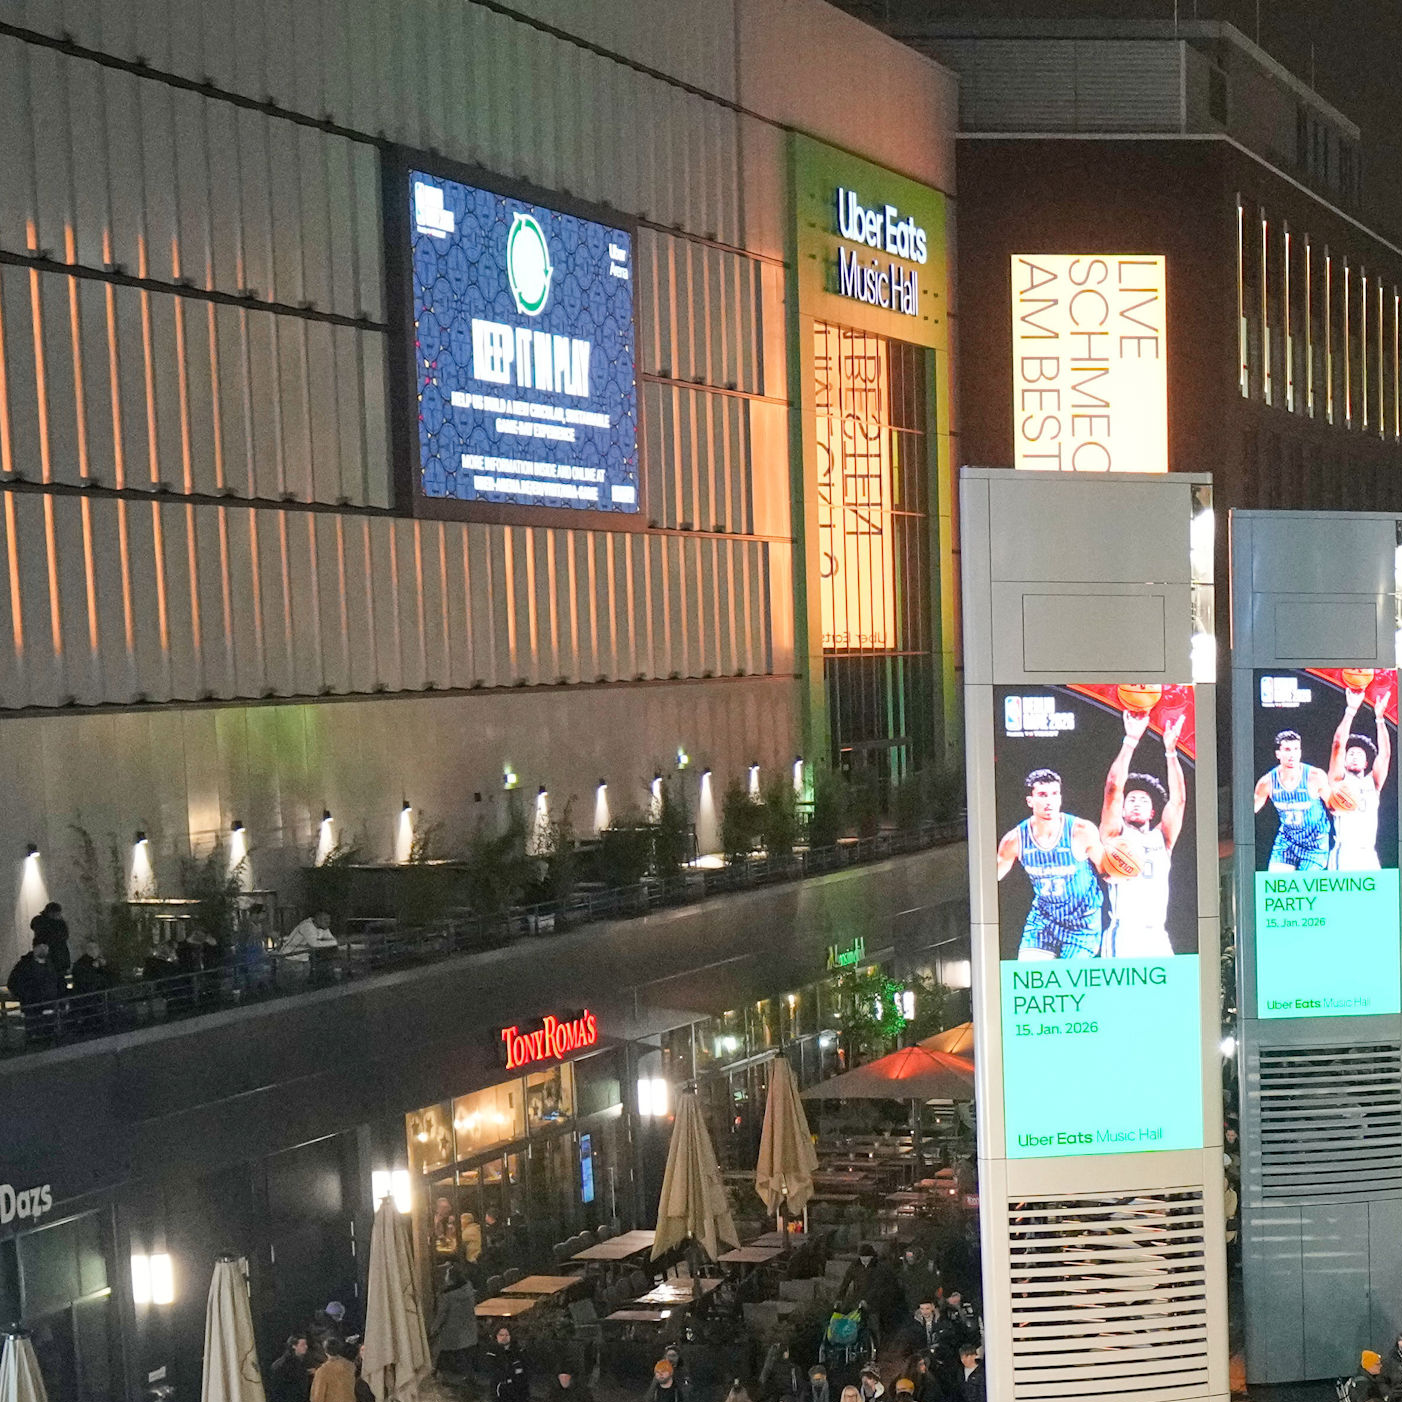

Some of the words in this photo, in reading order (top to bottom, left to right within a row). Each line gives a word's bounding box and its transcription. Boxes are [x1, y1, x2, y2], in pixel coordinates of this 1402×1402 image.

[838, 187, 884, 249] Uber
[884, 203, 928, 265] Eats
[839, 246, 890, 308] Music
[890, 263, 919, 317] Hall
[1018, 258, 1060, 339] AM
[1117, 260, 1160, 359] LIVE
[471, 318, 515, 385] KEEP
[515, 326, 533, 389] IT
[552, 333, 591, 398] PLAY
[1020, 356, 1062, 471] BEST
[1264, 879, 1300, 893] NBA
[1303, 877, 1376, 892] VIEWING
[1265, 896, 1317, 912] PARTY
[1301, 917, 1327, 927] 2026
[1013, 970, 1062, 990] NBA
[1066, 966, 1167, 988] VIEWING
[1013, 993, 1086, 1015] PARTY
[1266, 1000, 1293, 1010] Uber
[1295, 998, 1321, 1009] Eats
[1015, 1024, 1034, 1036] 15.
[1036, 1023, 1062, 1036] Jan.
[1065, 1021, 1099, 1034] 2026
[1018, 1133, 1054, 1147] Uber
[1056, 1131, 1094, 1145] Eats
[1096, 1129, 1136, 1143] Music
[1138, 1127, 1163, 1141] Hall
[0, 1184, 53, 1224] Dazs
